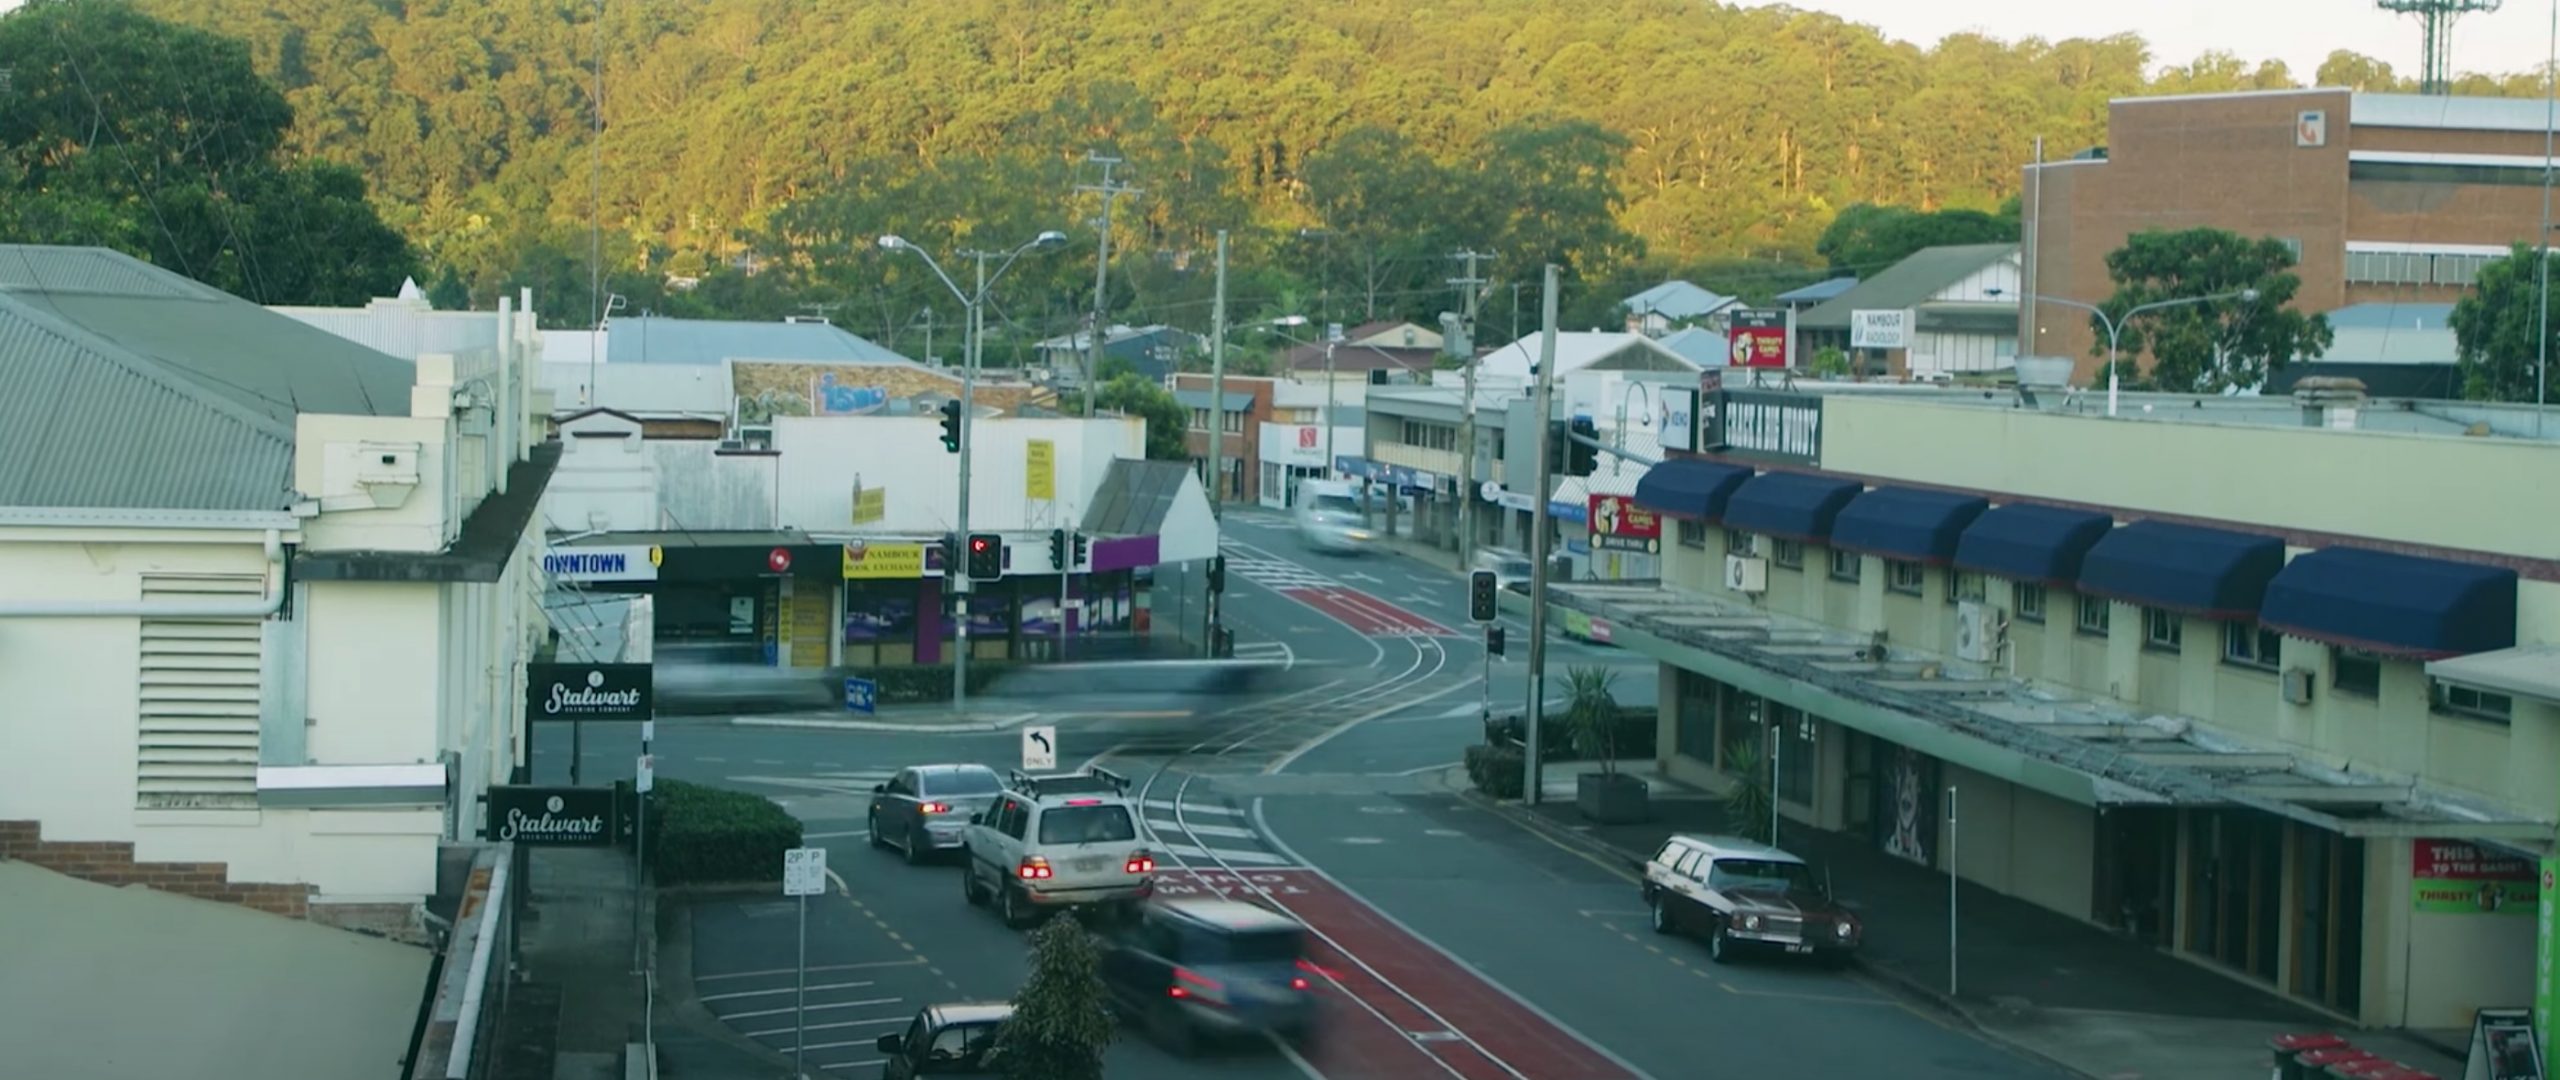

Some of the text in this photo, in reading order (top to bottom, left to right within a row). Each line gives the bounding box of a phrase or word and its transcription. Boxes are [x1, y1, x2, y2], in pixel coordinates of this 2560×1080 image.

[869, 550, 919, 559] NAMBOUR
[544, 554, 625, 573] OWNTOWN
[845, 563, 869, 572] BOOK
[544, 682, 640, 714] Stalwart
[1025, 757, 1051, 766] ONLY
[500, 807, 603, 841] Stalwart
[787, 851, 821, 865] 2P P
[2431, 846, 2475, 862] THIS
[2432, 863, 2451, 873] TO
[2453, 863, 2476, 873] THE
[2418, 890, 2472, 902] THIRSTY
